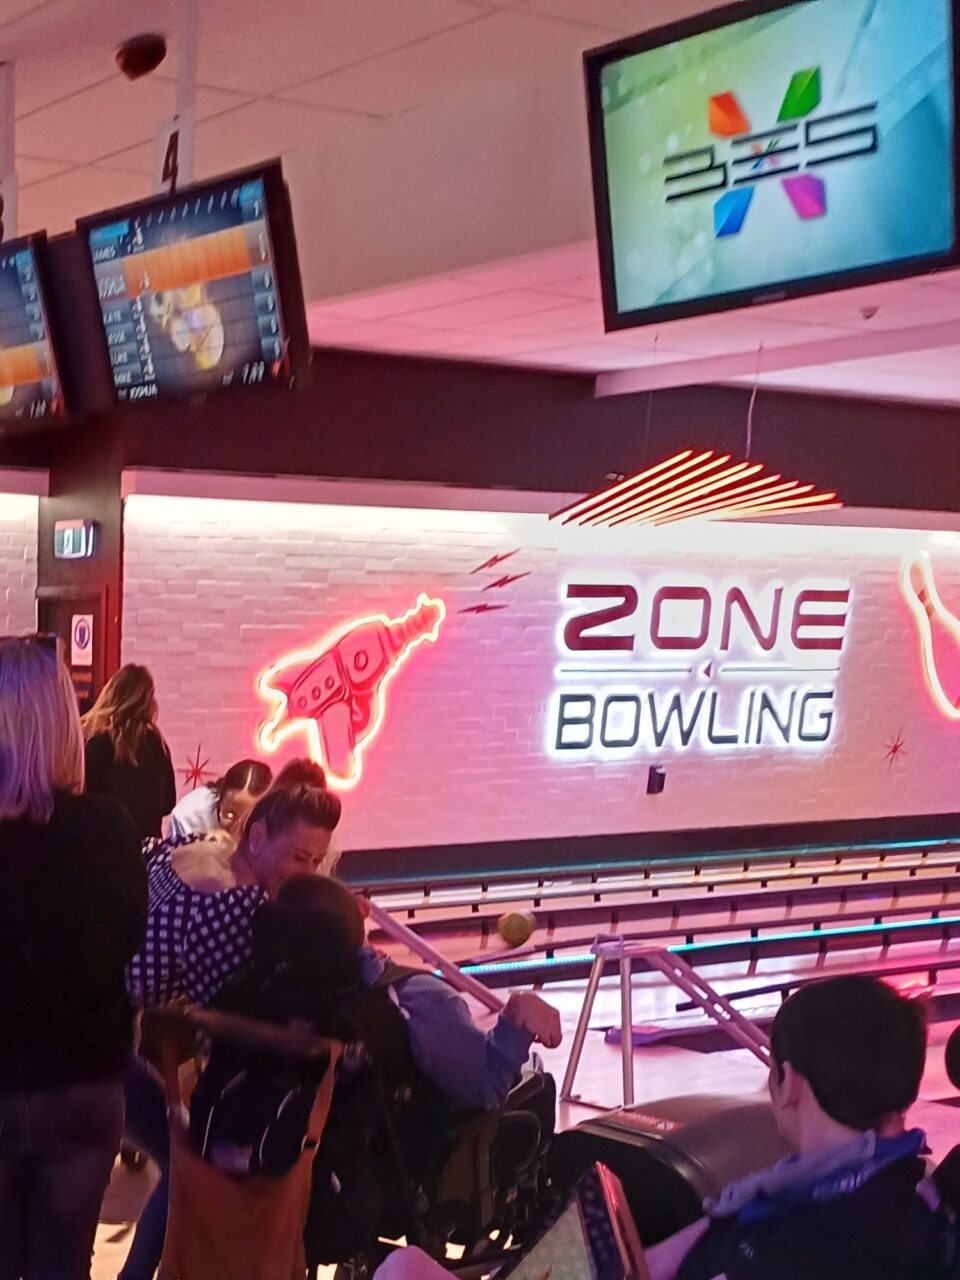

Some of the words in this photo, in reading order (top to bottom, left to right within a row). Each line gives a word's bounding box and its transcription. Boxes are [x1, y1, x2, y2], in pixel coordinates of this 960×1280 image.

[162, 130, 179, 194] 4
[563, 583, 852, 651] ZONE
[555, 689, 835, 750] BOWLING
